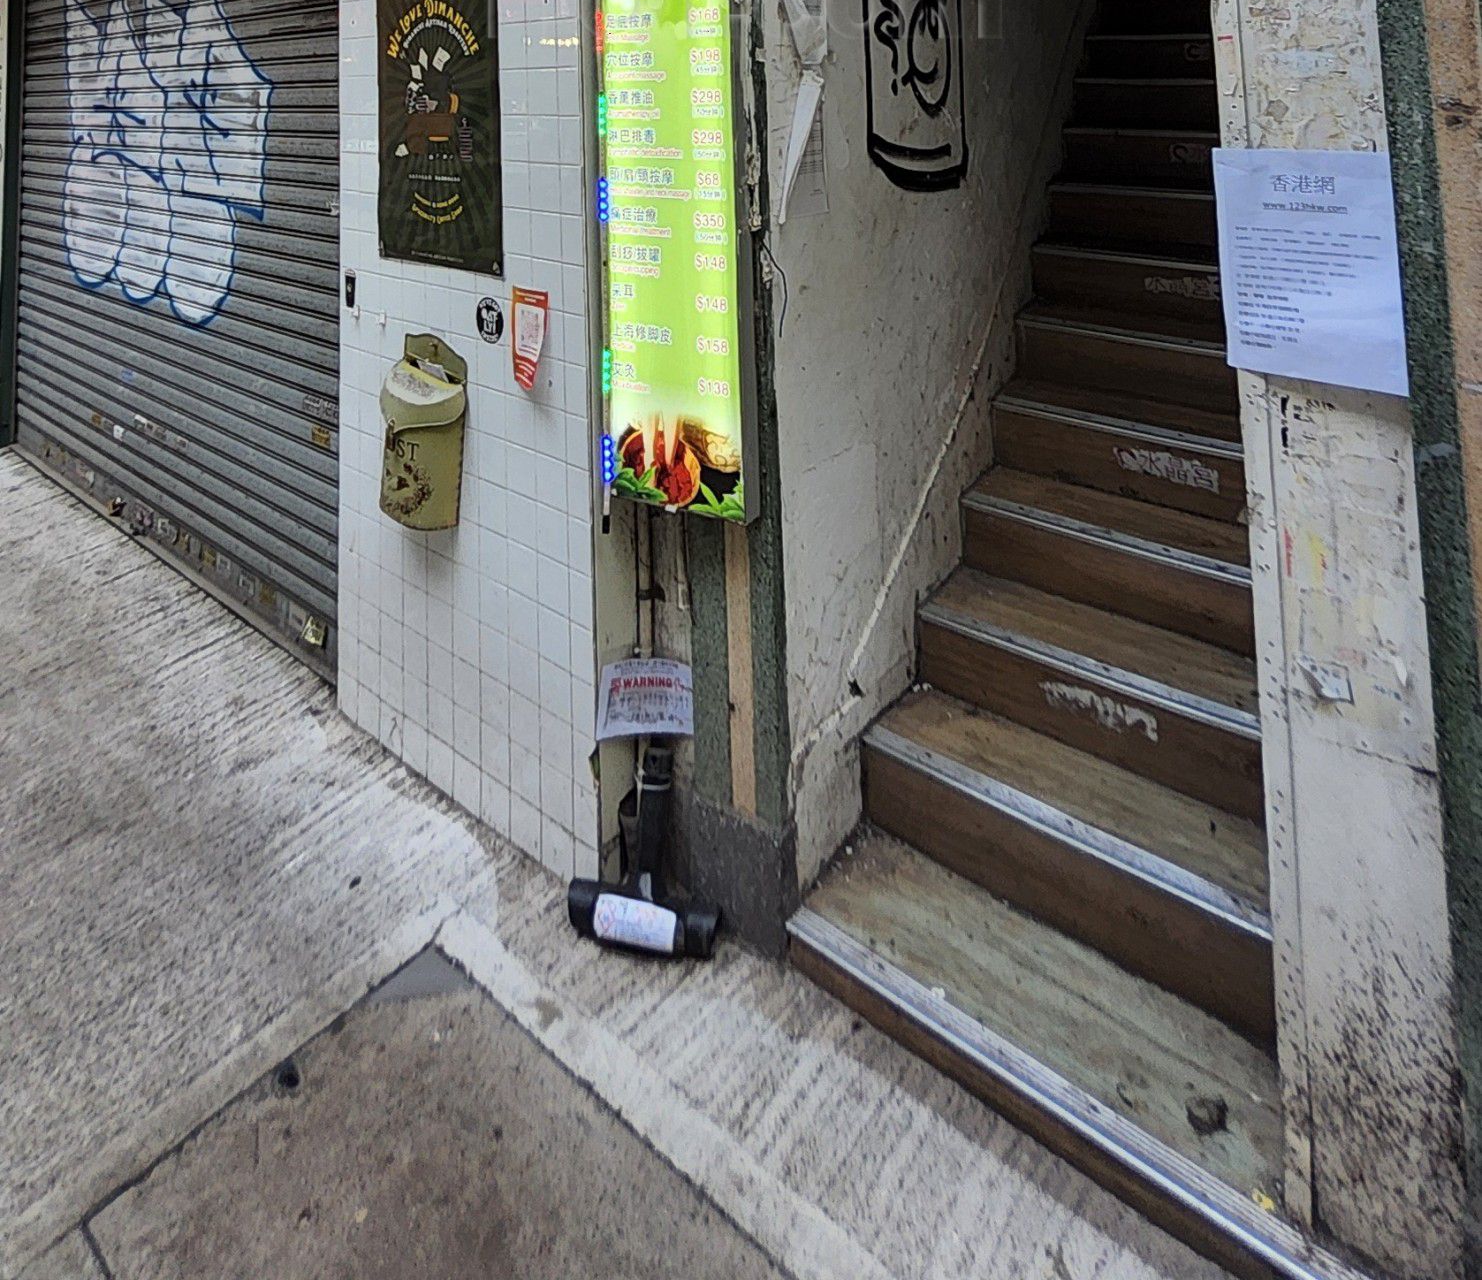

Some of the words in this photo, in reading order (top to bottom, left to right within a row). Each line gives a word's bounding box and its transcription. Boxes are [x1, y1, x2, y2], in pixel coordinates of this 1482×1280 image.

[399, 4, 422, 35] LOVE
[688, 8, 720, 24] $168
[690, 48, 721, 64] $198
[691, 90, 722, 105] $298
[692, 130, 723, 145] $298
[697, 172, 720, 187] $68
[1270, 173, 1336, 195] 香港網
[694, 212, 725, 228] $350
[695, 253, 726, 270] $148
[696, 295, 727, 313] $148
[697, 336, 729, 354] $158
[698, 379, 729, 397] $138
[623, 675, 673, 690] WARNING
